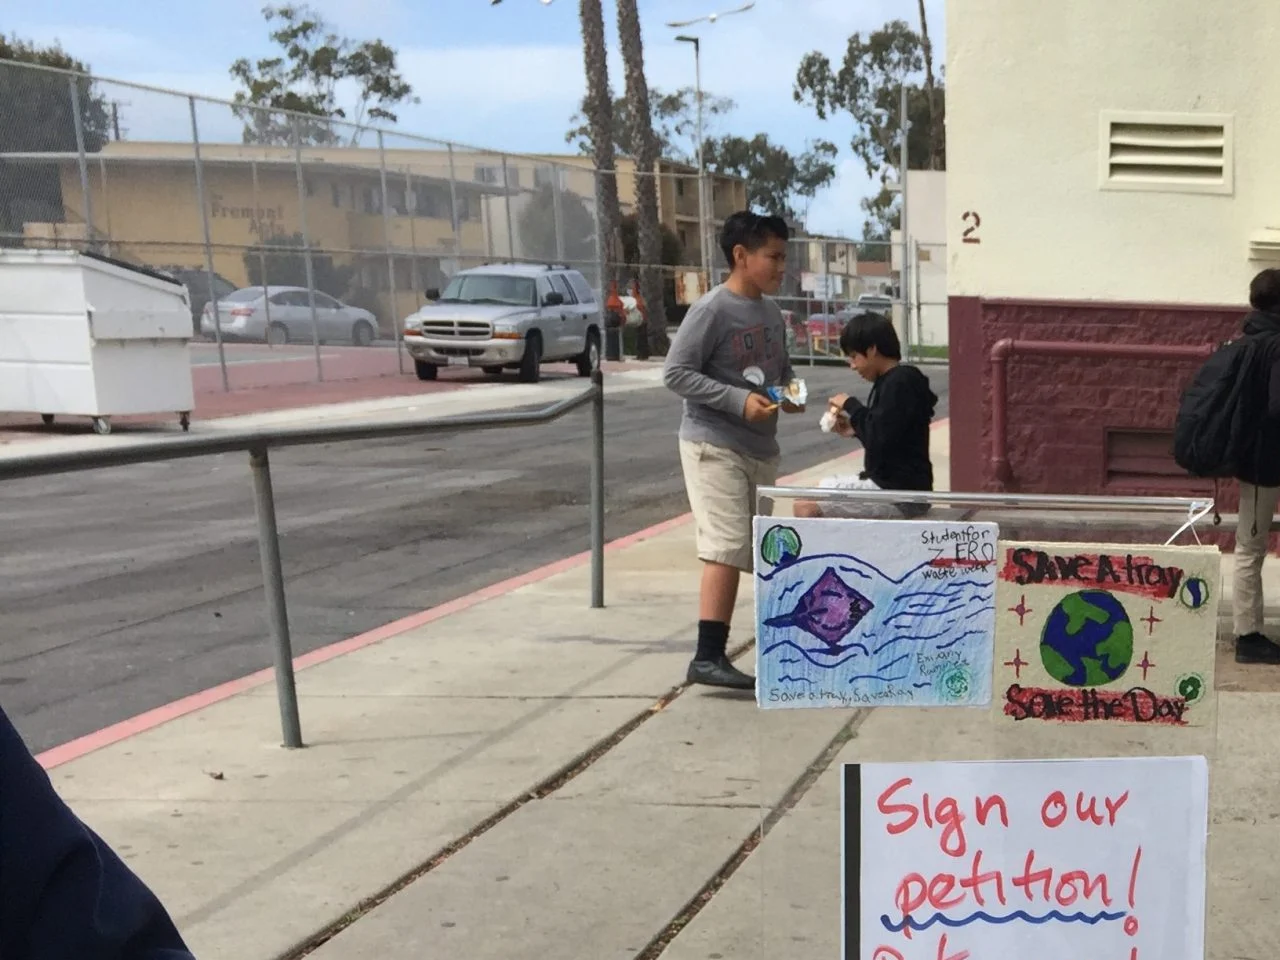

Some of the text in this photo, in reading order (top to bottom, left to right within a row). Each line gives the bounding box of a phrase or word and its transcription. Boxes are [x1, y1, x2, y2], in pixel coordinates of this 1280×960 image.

[962, 211, 981, 244] 2
[922, 566, 958, 580] waste
[768, 688, 805, 702] Save
[1077, 688, 1124, 720] the
[1122, 686, 1185, 721] Day
[877, 777, 1129, 857] Sign our
[895, 845, 1142, 939] petition!
